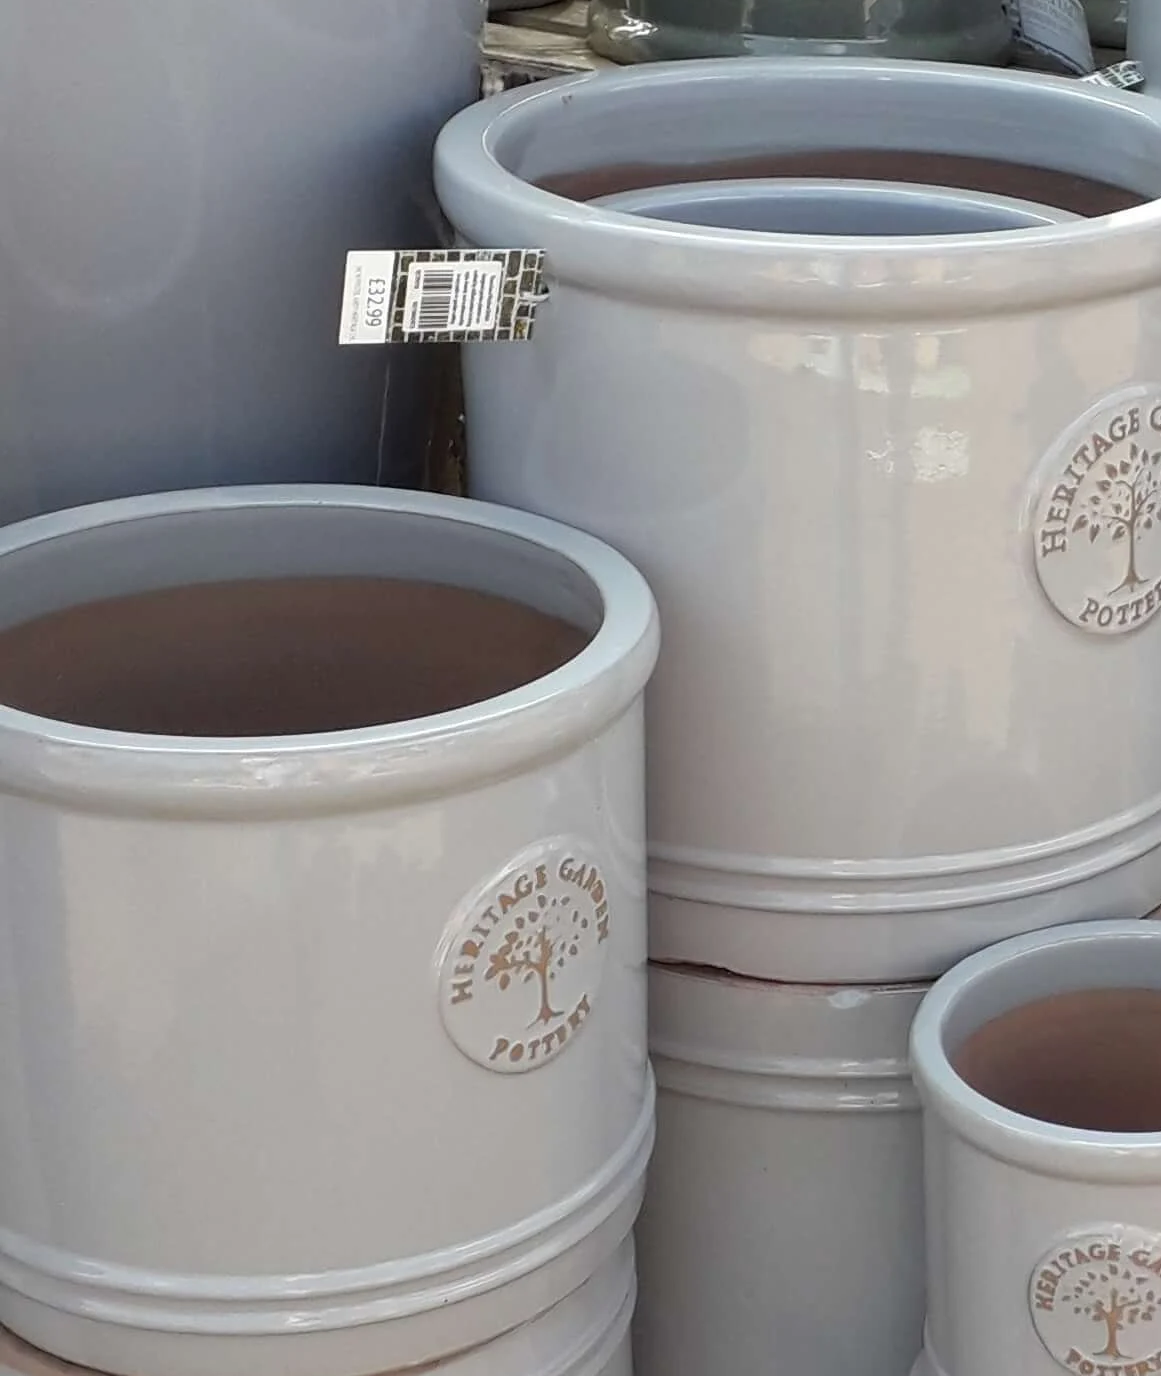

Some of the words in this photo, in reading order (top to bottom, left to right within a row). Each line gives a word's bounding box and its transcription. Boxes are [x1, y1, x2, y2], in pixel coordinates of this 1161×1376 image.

[366, 278, 385, 327] £32.99
[1042, 407, 1140, 557] HERITAGE
[451, 864, 548, 1005] HERITAGE
[559, 857, 609, 944] GARDEN
[489, 993, 591, 1062] POTTERY
[1036, 1243, 1121, 1311] HERITAGE
